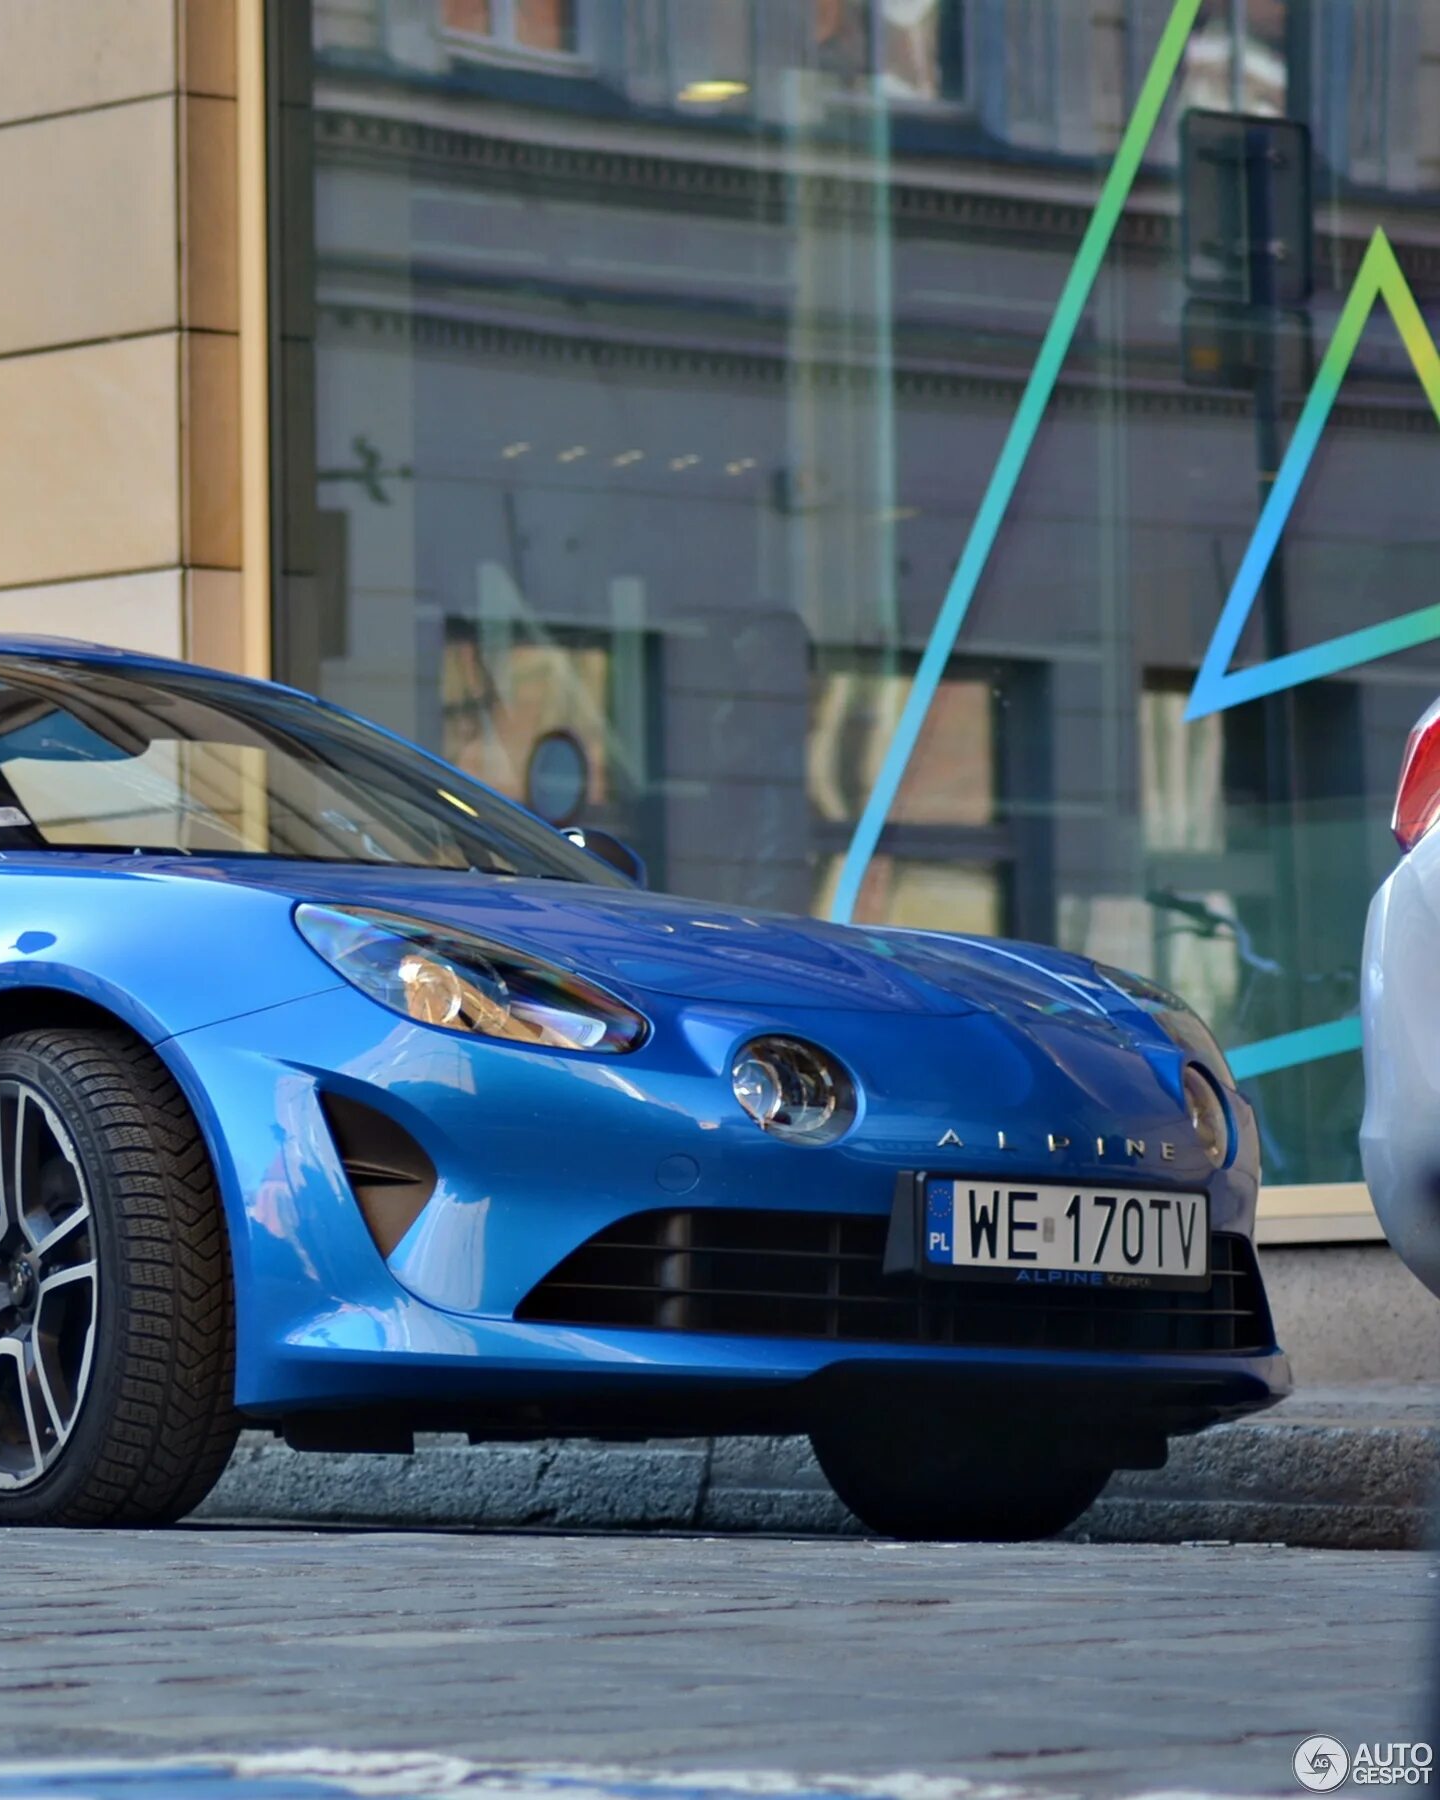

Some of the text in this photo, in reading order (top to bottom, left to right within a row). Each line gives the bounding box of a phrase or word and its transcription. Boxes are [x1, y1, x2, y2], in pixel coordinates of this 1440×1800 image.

[937, 1128, 1176, 1161] ALPINE
[929, 1231, 950, 1251] PL
[968, 1189, 1197, 1270] WE 170TV
[1015, 1269, 1104, 1286] ALPINE
